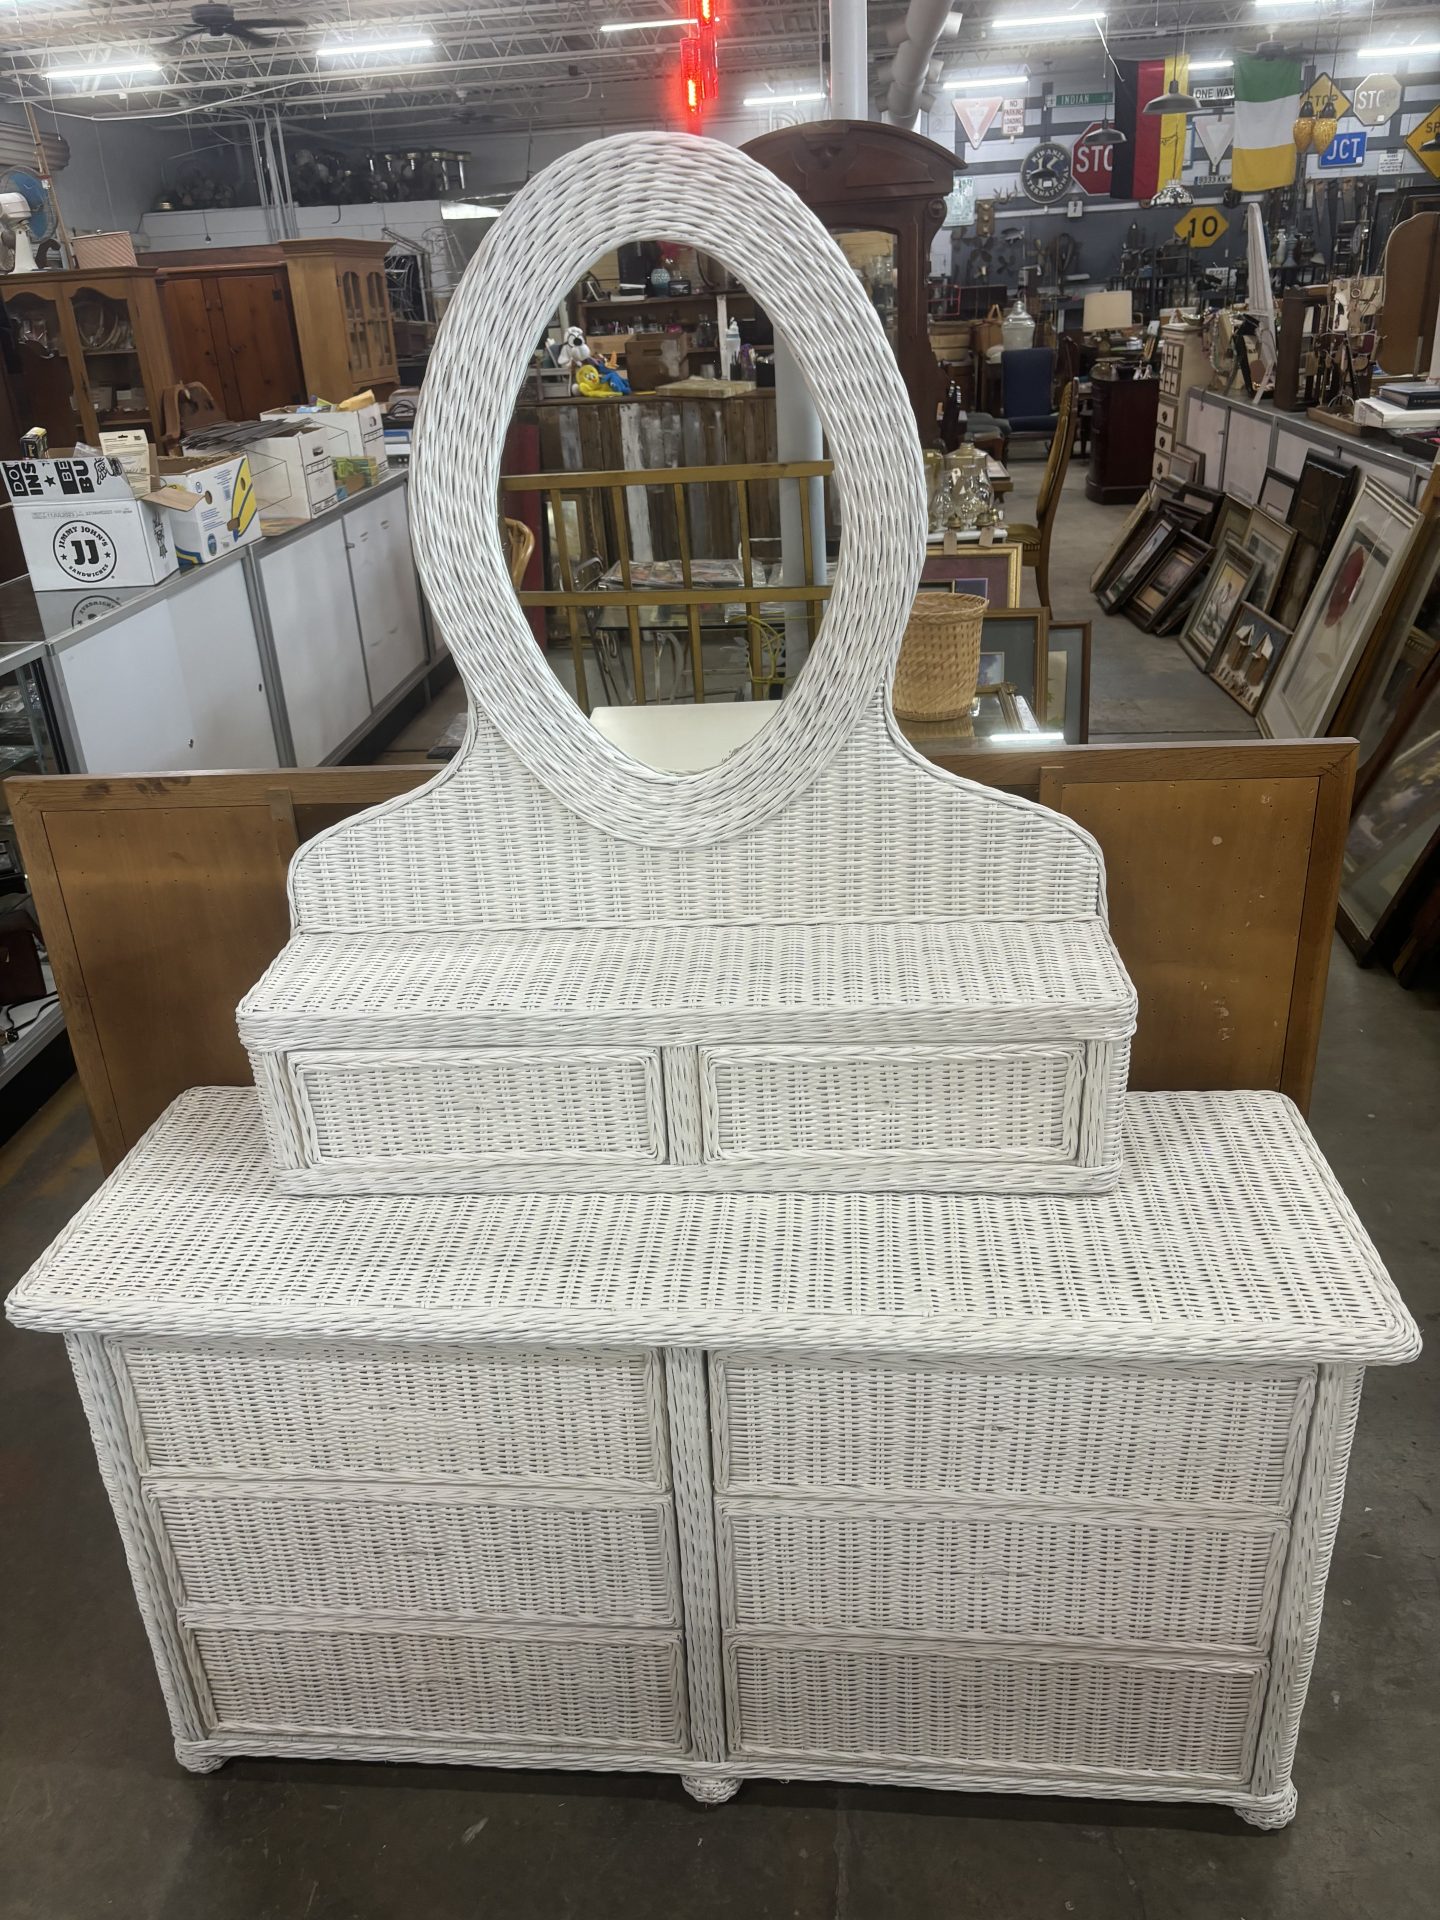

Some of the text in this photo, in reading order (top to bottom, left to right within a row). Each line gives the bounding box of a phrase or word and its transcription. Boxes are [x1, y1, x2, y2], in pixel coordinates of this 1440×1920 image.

[1009, 100, 1018, 108] NO
[1061, 94, 1089, 105] INDIAN
[1195, 87, 1235, 99] ONE WAY
[1357, 89, 1385, 110] STO
[1076, 144, 1113, 173] STO
[1327, 138, 1361, 161] JCT
[1189, 215, 1218, 238] 10
[58, 526, 108, 549] JIMMY JOHN'S
[70, 539, 100, 565] JJ
[68, 563, 109, 578] SANDWICHES
